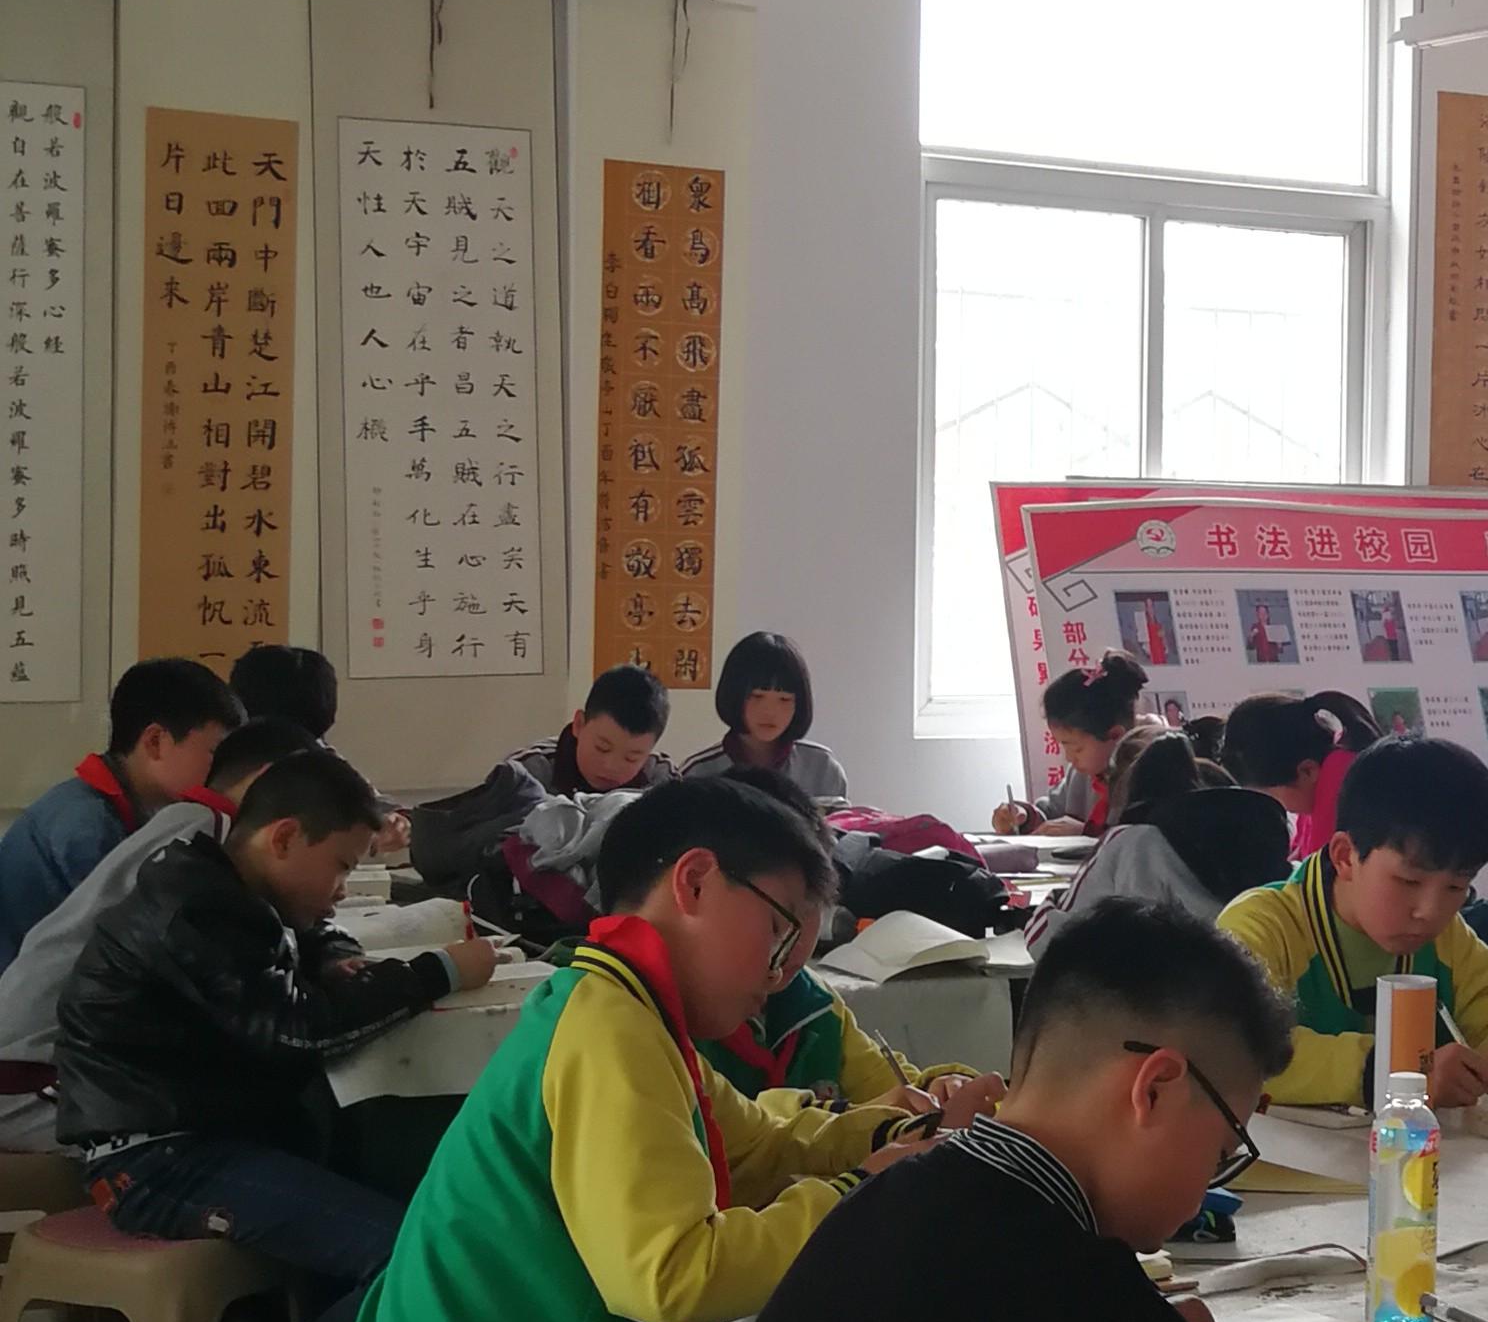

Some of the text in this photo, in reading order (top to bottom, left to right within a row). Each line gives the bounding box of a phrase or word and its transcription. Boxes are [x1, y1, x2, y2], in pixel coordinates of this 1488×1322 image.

[1206, 523, 1438, 564] 书法进校园
